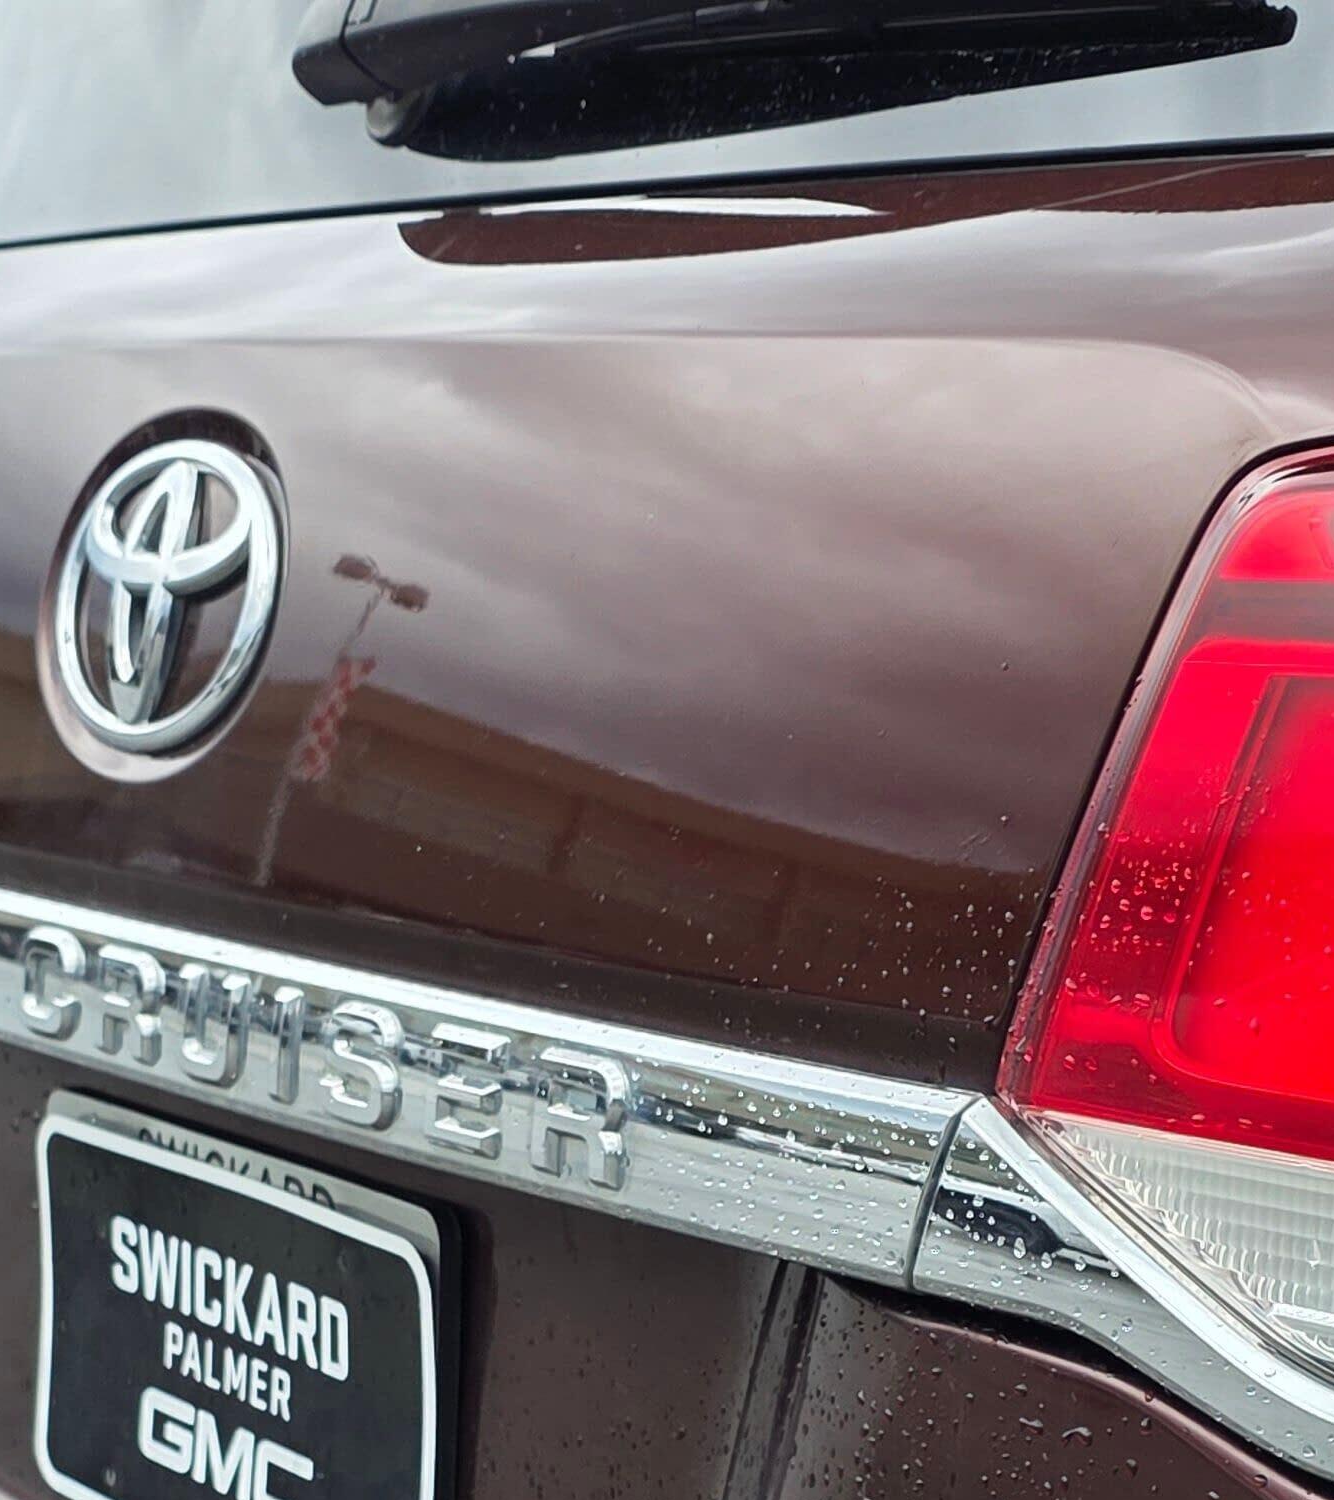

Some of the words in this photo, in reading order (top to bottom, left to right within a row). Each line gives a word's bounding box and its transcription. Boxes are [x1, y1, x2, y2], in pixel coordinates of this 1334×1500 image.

[19, 924, 632, 1192] CRUISER
[109, 1214, 350, 1382] SWICKARD
[162, 1321, 293, 1423] PALMER
